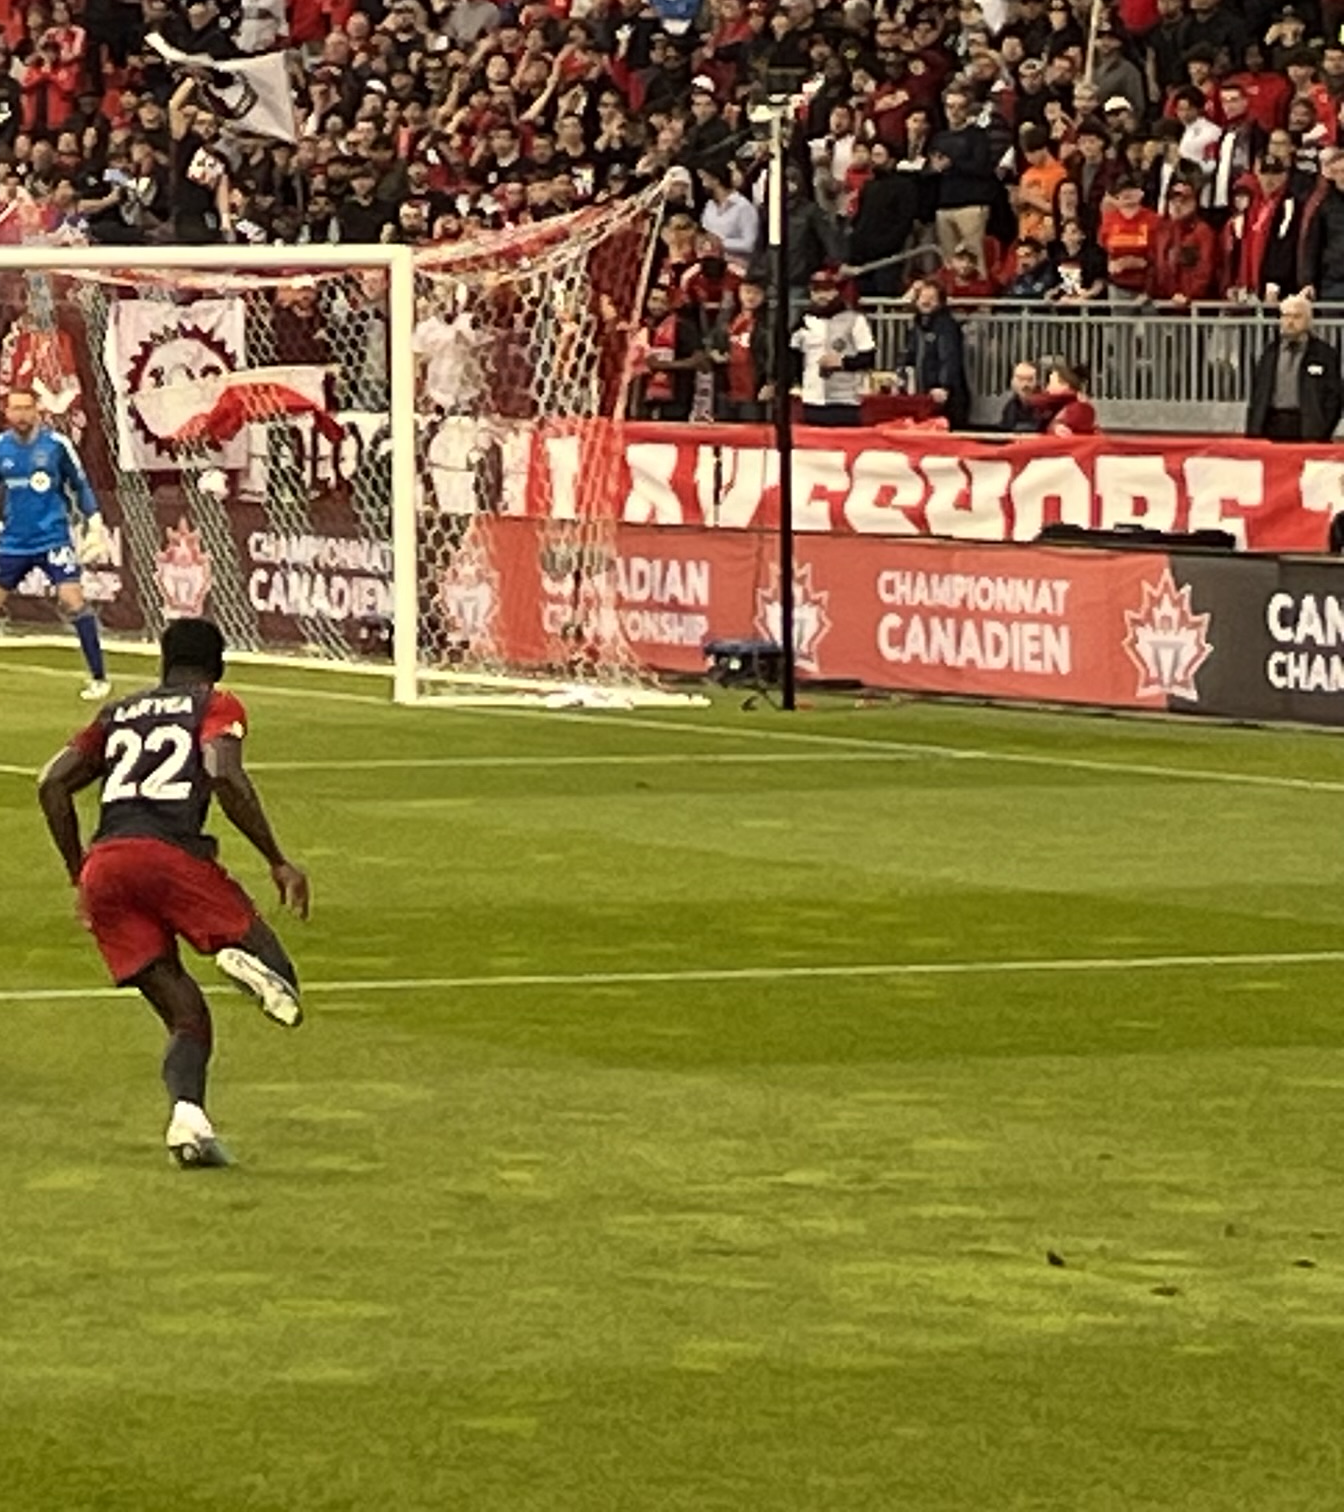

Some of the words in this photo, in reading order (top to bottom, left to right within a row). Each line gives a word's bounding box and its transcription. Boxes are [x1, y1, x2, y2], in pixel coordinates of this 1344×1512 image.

[877, 569, 1070, 616] CHAMPIONNAT
[877, 612, 1071, 675] CANADIEN
[102, 724, 193, 802] 22
